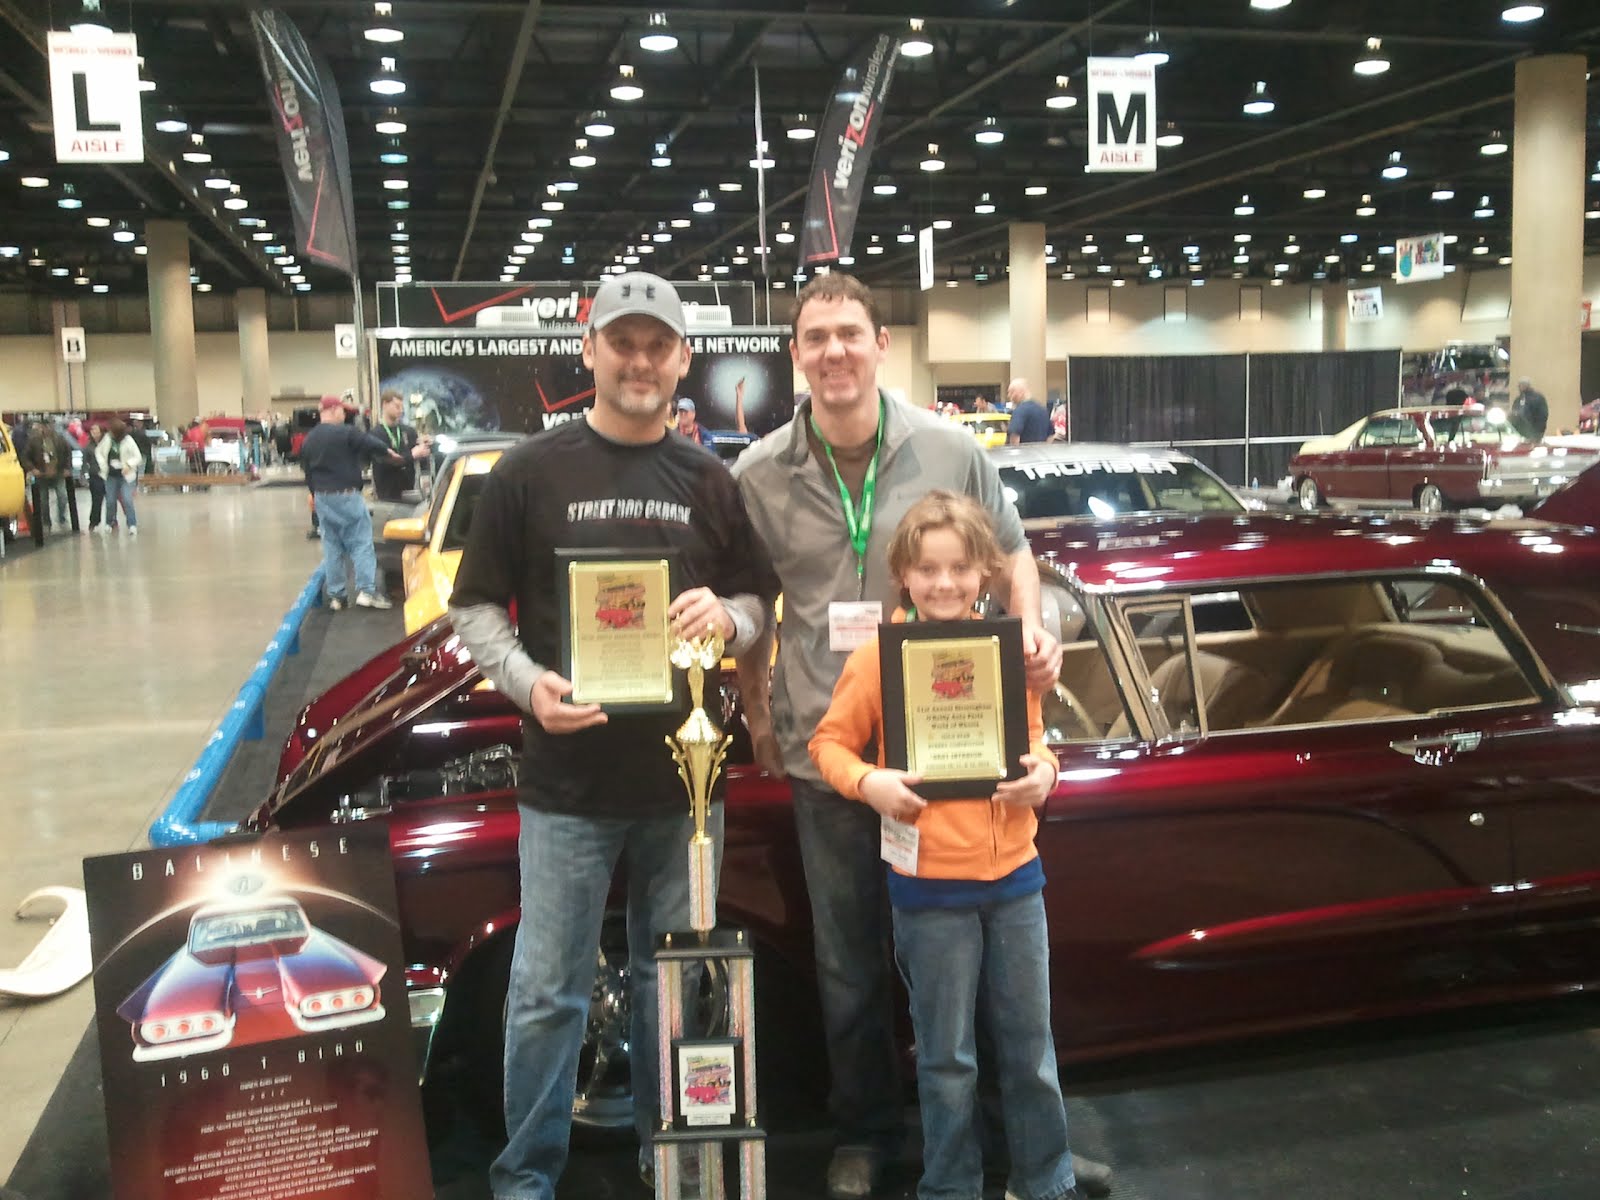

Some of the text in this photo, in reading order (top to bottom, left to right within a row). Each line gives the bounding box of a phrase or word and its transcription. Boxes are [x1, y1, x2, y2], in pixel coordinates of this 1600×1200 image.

[72, 71, 121, 131] L
[1097, 91, 1146, 144] M
[71, 139, 125, 152] AISLE
[833, 93, 873, 190] verizon
[1100, 151, 1143, 163] AISLE
[389, 339, 475, 357] AMERICA'S
[478, 339, 548, 356] LARGEST
[549, 338, 583, 355] AND
[705, 336, 780, 354] NETWORK
